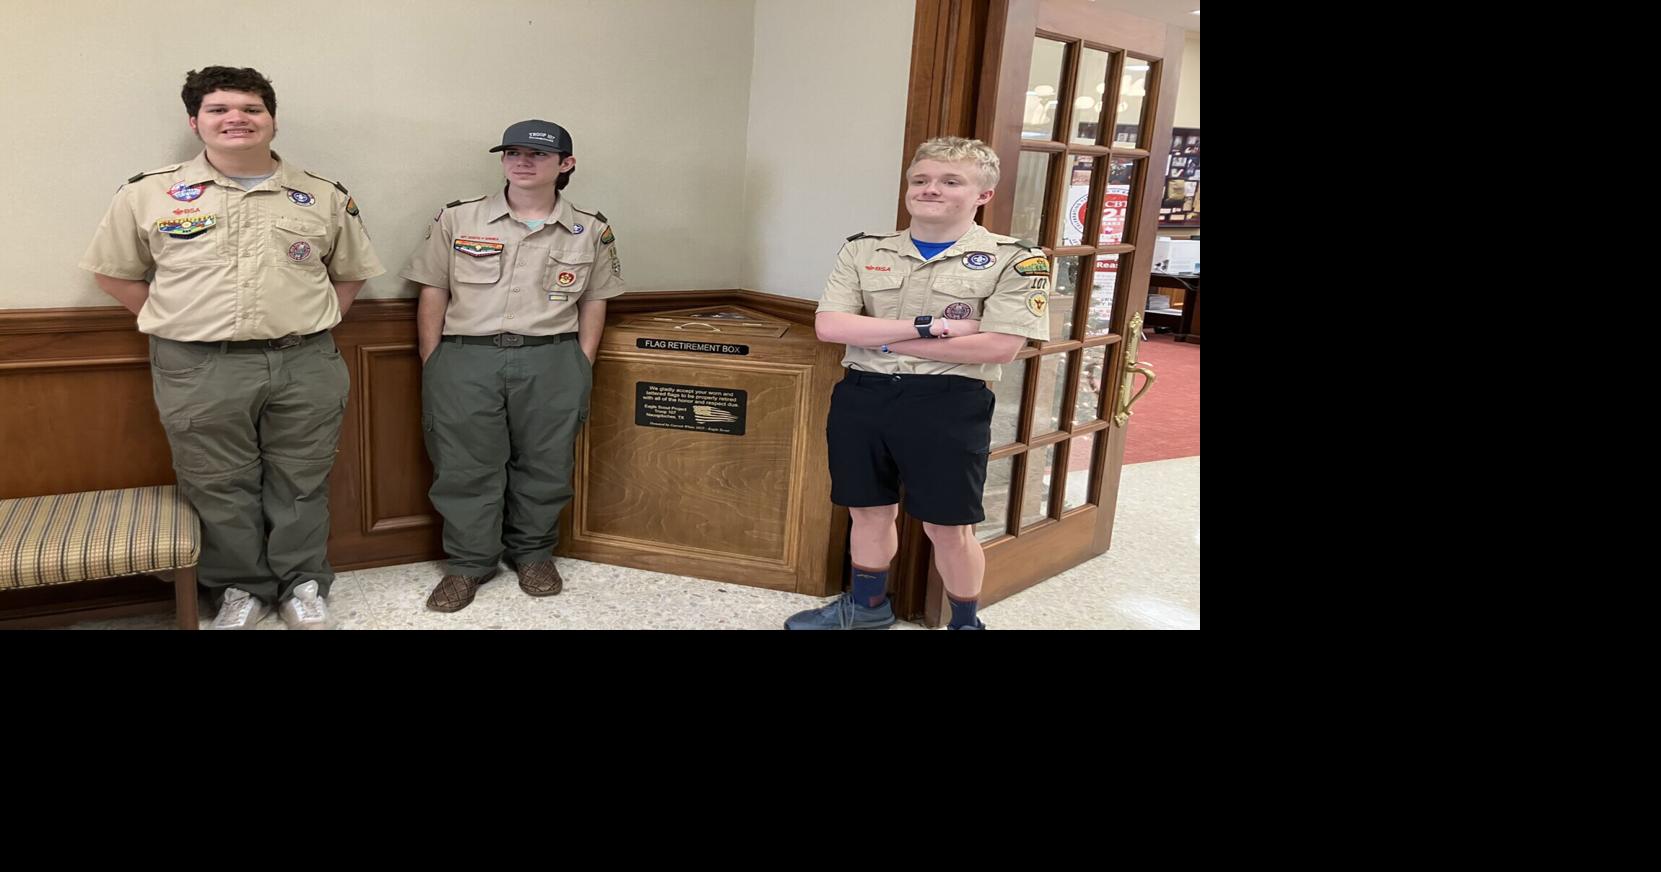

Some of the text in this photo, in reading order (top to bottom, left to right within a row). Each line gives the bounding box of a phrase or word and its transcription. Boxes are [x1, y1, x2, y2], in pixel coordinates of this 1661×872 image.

[1031, 277, 1047, 289] 107
[645, 339, 740, 353] FLAG RETIREMENT BOX
